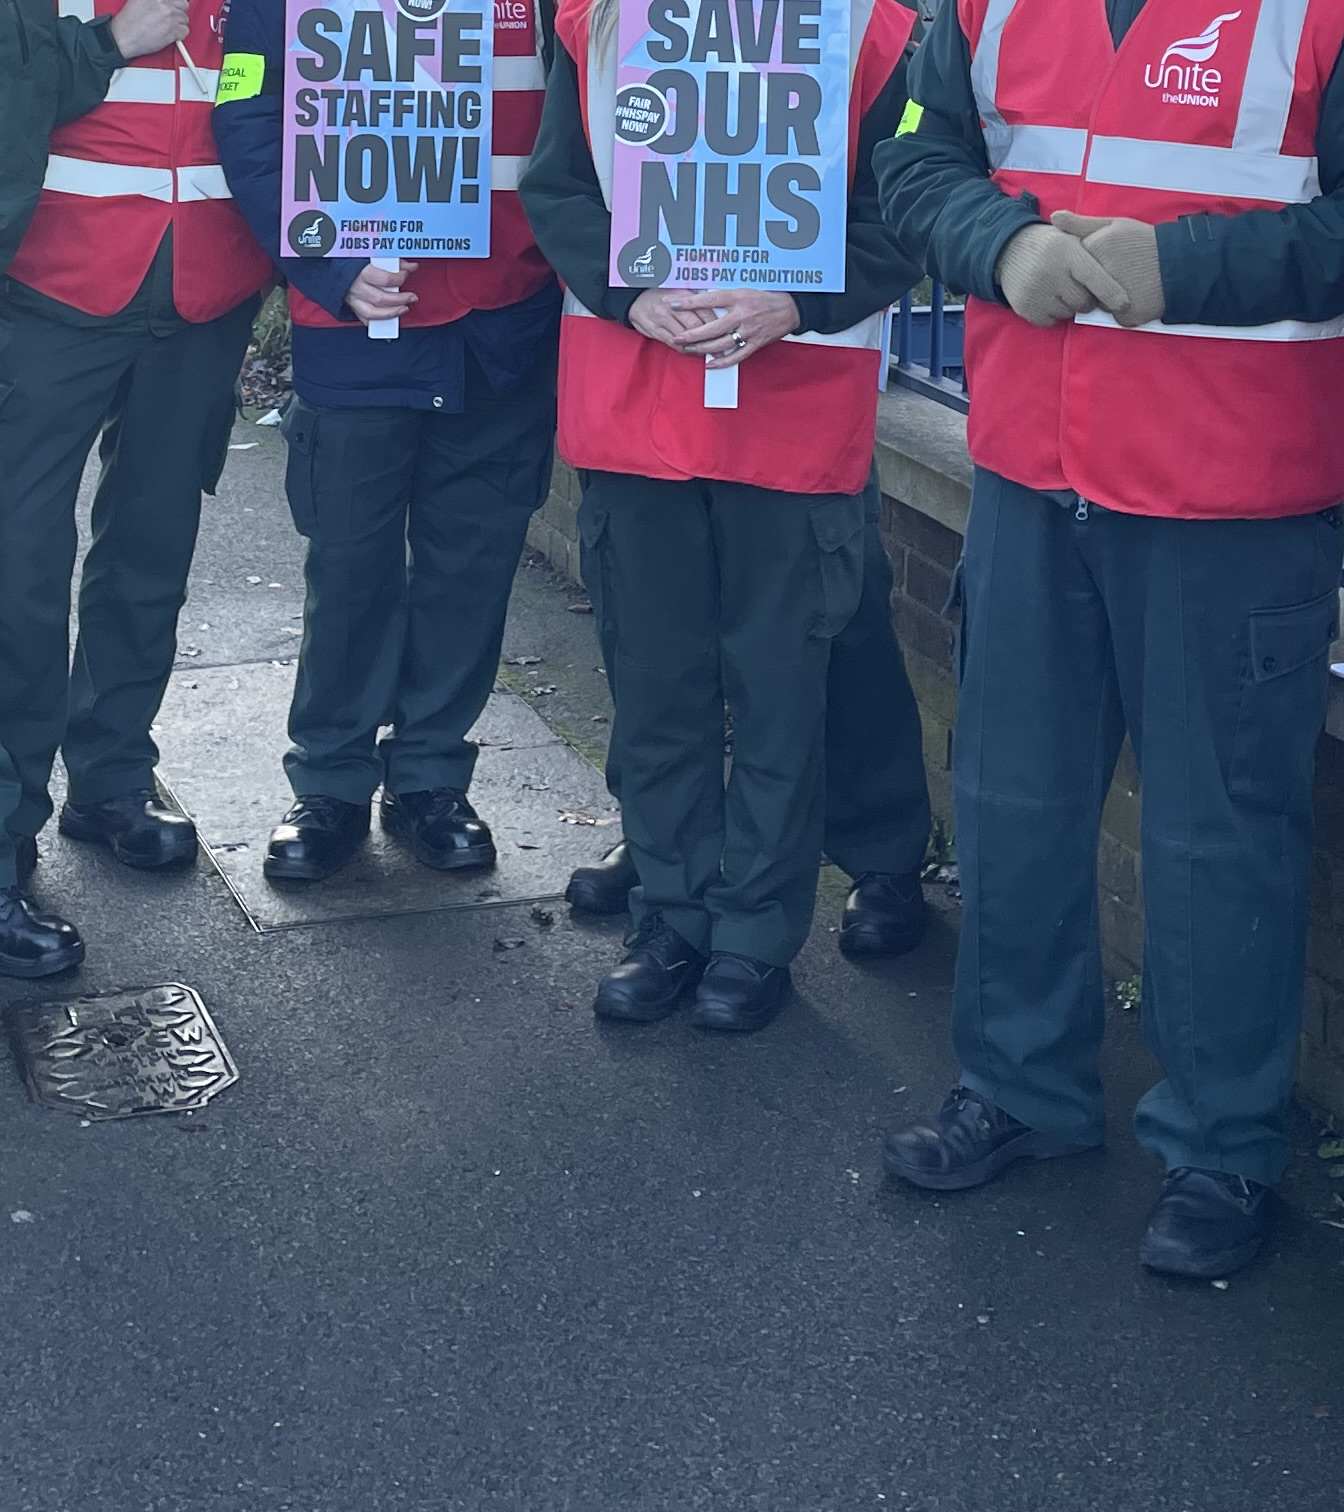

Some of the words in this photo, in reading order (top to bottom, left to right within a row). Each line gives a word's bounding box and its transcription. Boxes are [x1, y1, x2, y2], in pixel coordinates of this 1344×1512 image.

[295, 7, 483, 85] SAFE
[1144, 63, 1222, 93] unite
[295, 88, 482, 130] STAFFING
[628, 95, 652, 110] FAIR
[645, 68, 821, 156] OUR
[615, 105, 661, 124] #NHSPAY
[621, 119, 649, 134] NOW!
[294, 134, 480, 204] NOW!
[639, 161, 821, 250] NHS
[340, 219, 397, 233] FIGHTING
[400, 220, 424, 233] FOR
[339, 237, 370, 250] JOBS
[372, 238, 395, 250] PAY
[397, 238, 471, 251] CONDITIONS
[676, 248, 740, 263] FIGHTING
[743, 250, 769, 264] FOR
[675, 267, 709, 281] JOBS
[711, 268, 736, 282] PAY
[740, 268, 823, 284] CONDITIONS
